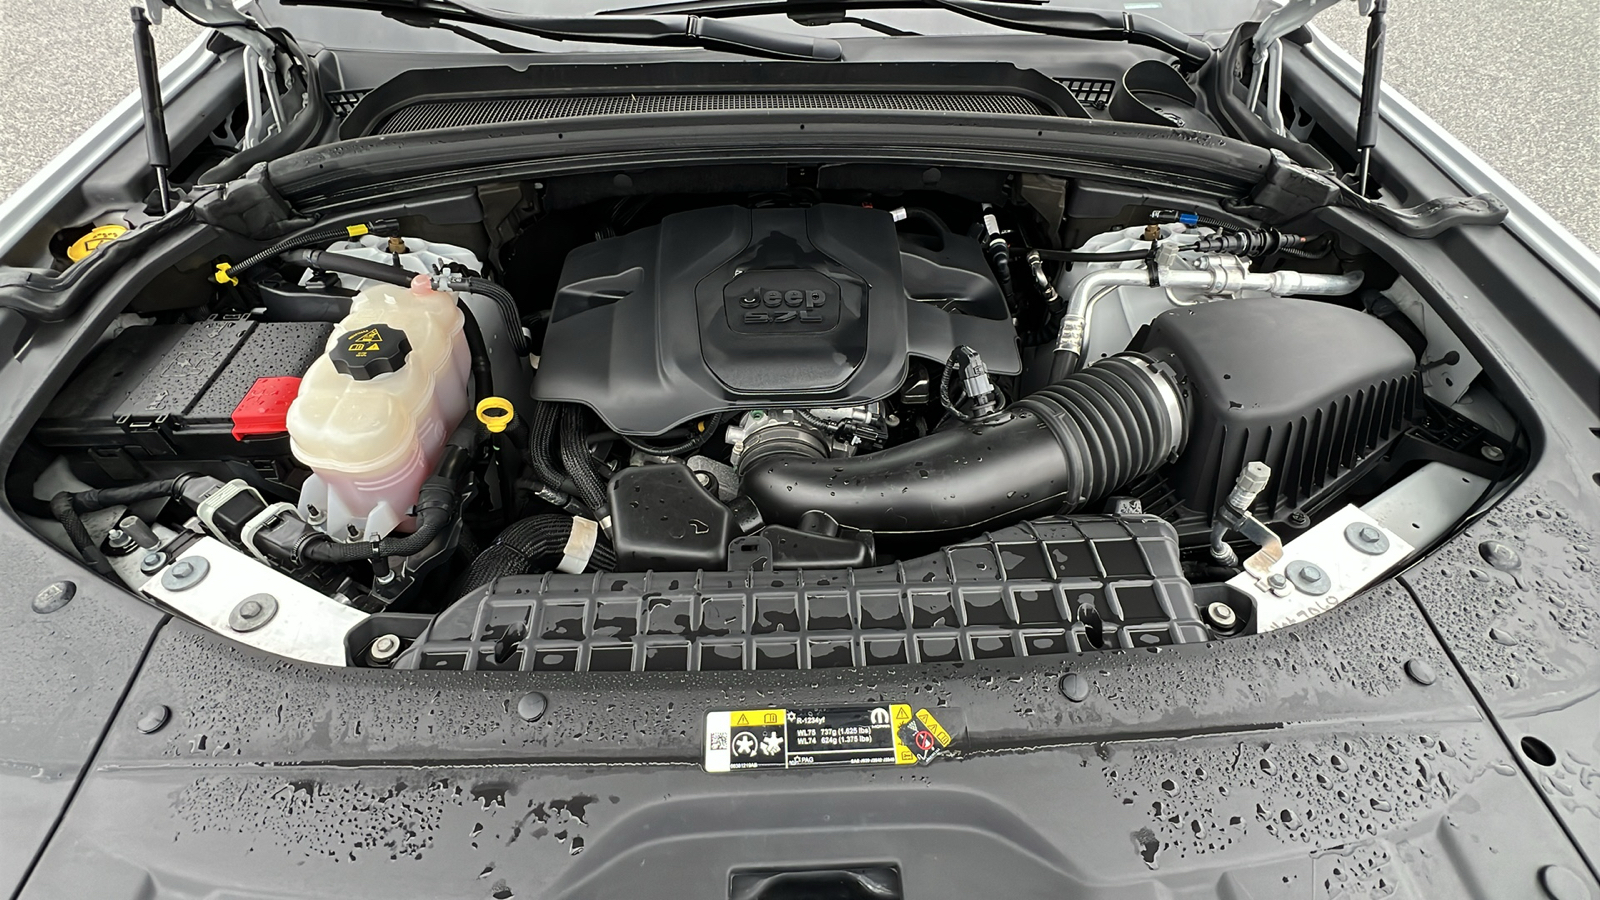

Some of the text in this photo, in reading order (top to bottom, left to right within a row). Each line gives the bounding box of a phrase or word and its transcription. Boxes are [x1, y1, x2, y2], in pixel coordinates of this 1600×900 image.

[739, 286, 826, 309] Jeep
[744, 310, 823, 324] 5.7L
[796, 716, 826, 725] R-1234yf
[796, 728, 817, 737] WL75
[820, 728, 837, 737] 737g
[837, 727, 858, 736] (1.625
[797, 736, 817, 745] WL74
[820, 736, 838, 745] 624g
[838, 735, 859, 745] (1.375
